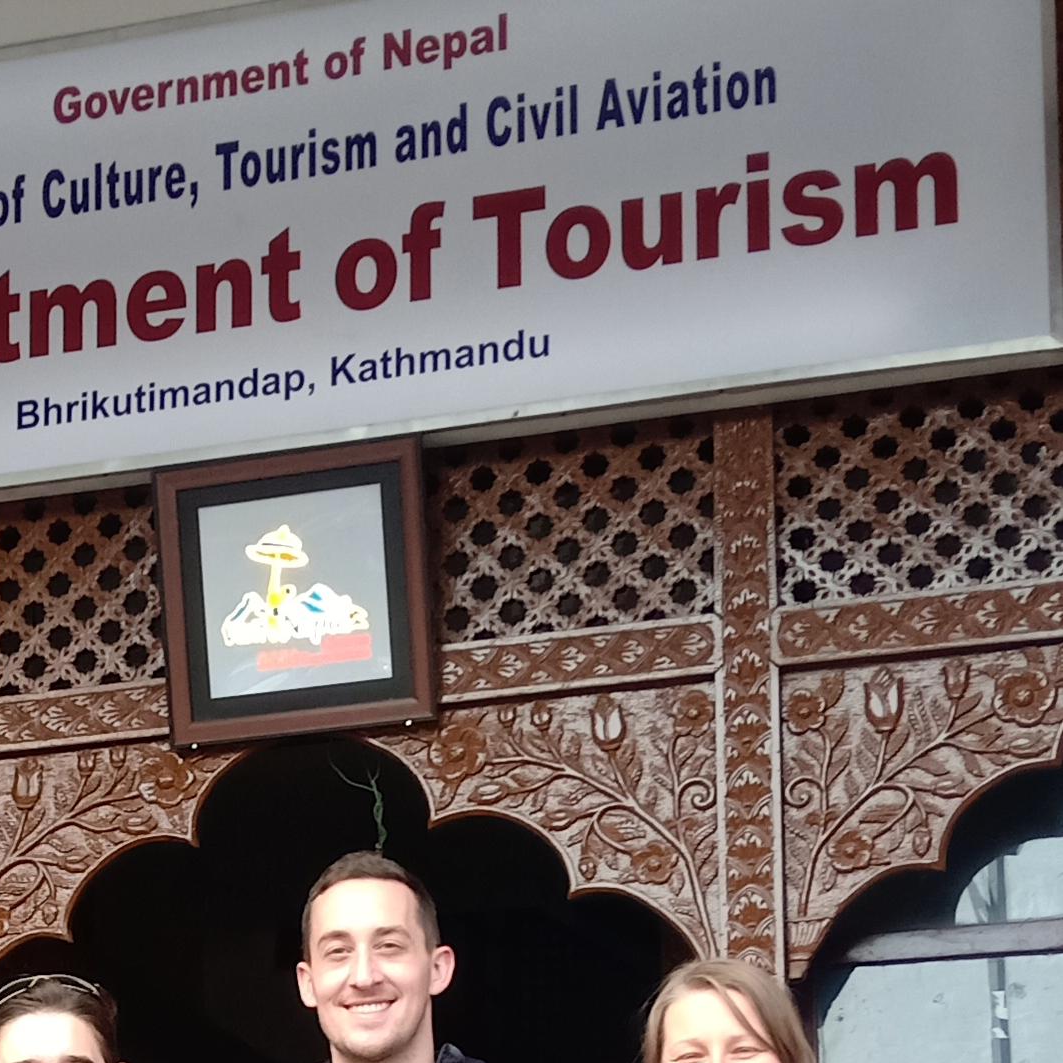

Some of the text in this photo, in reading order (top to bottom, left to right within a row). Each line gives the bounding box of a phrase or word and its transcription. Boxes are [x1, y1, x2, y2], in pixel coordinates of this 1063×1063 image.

[53, 13, 507, 124] Government of Nepal
[42, 161, 198, 218] Culture,
[215, 128, 377, 191] Tourism
[395, 102, 467, 163] and
[486, 84, 578, 147] Civil
[596, 61, 777, 131] Aviation
[335, 201, 446, 311] of
[472, 151, 959, 289] Tourism
[17, 330, 549, 430] Bhrikutimandap, Kathmandu
